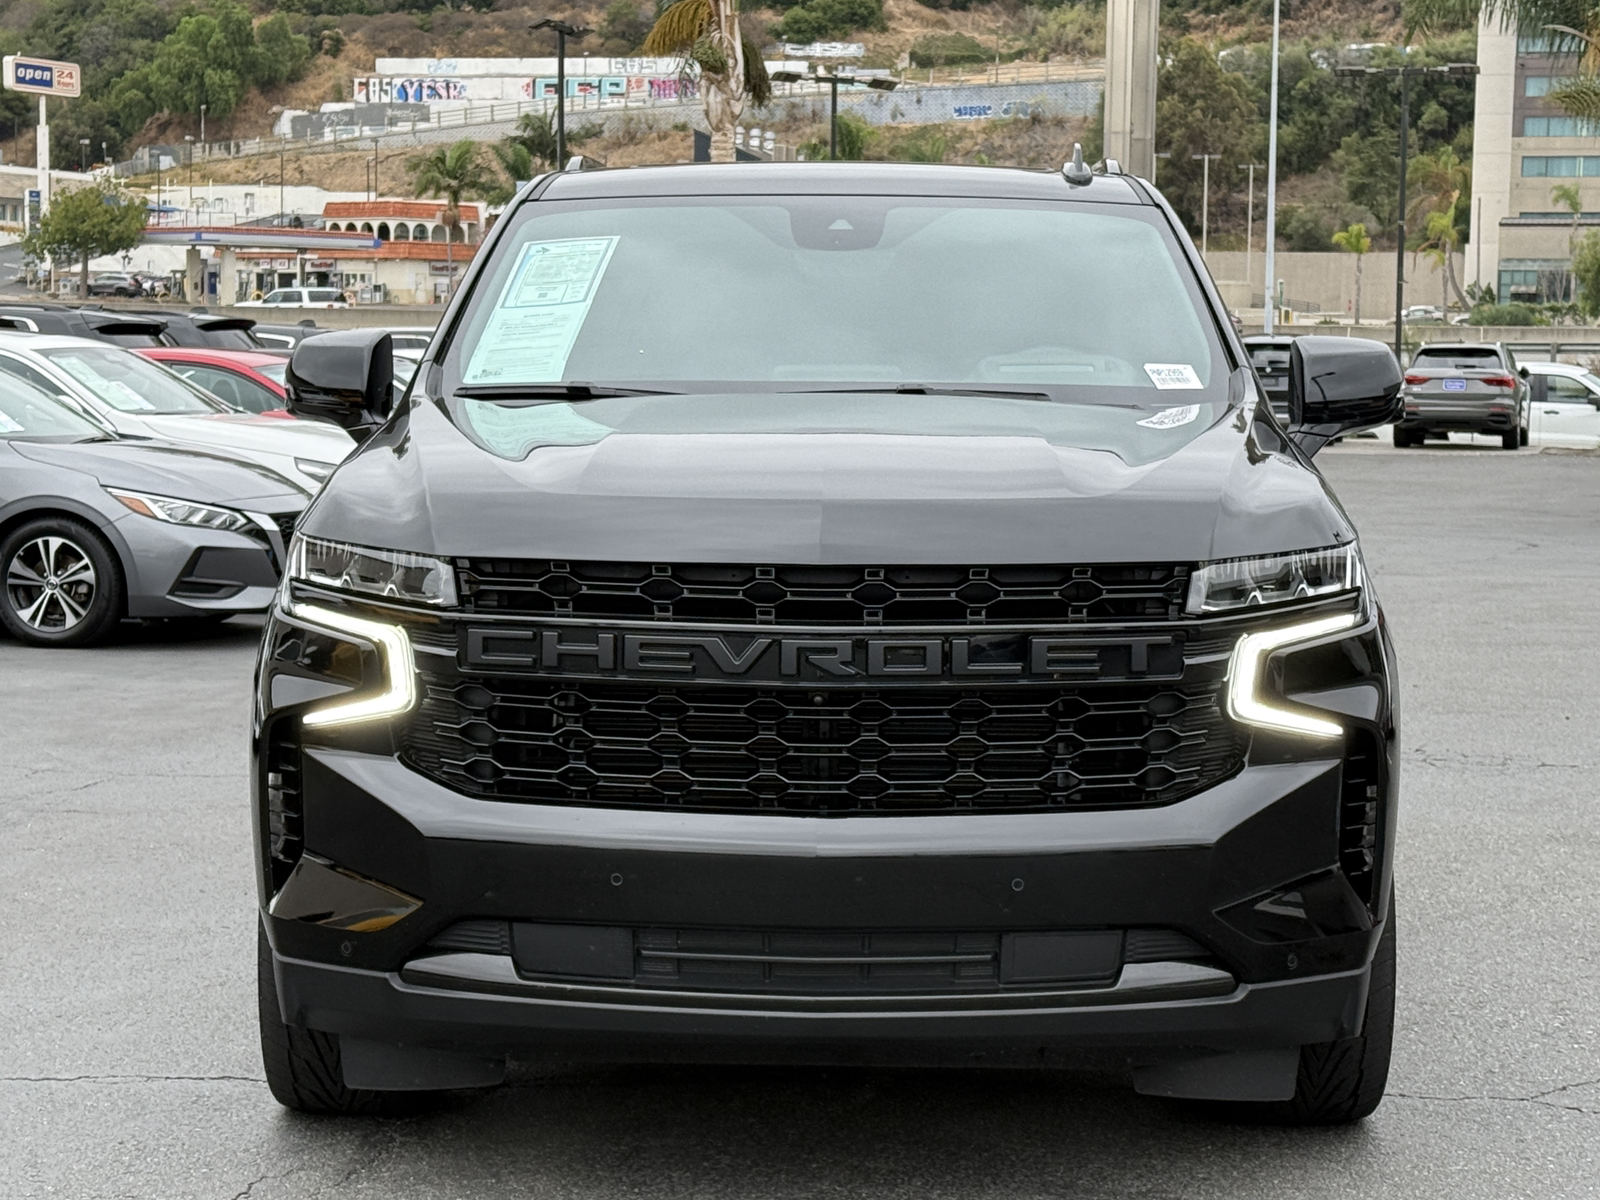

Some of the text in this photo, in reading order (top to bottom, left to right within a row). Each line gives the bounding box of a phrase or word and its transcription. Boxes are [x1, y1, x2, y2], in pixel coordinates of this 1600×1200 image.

[17, 67, 75, 81] open 24
[466, 628, 1174, 676] CHEVROLET
